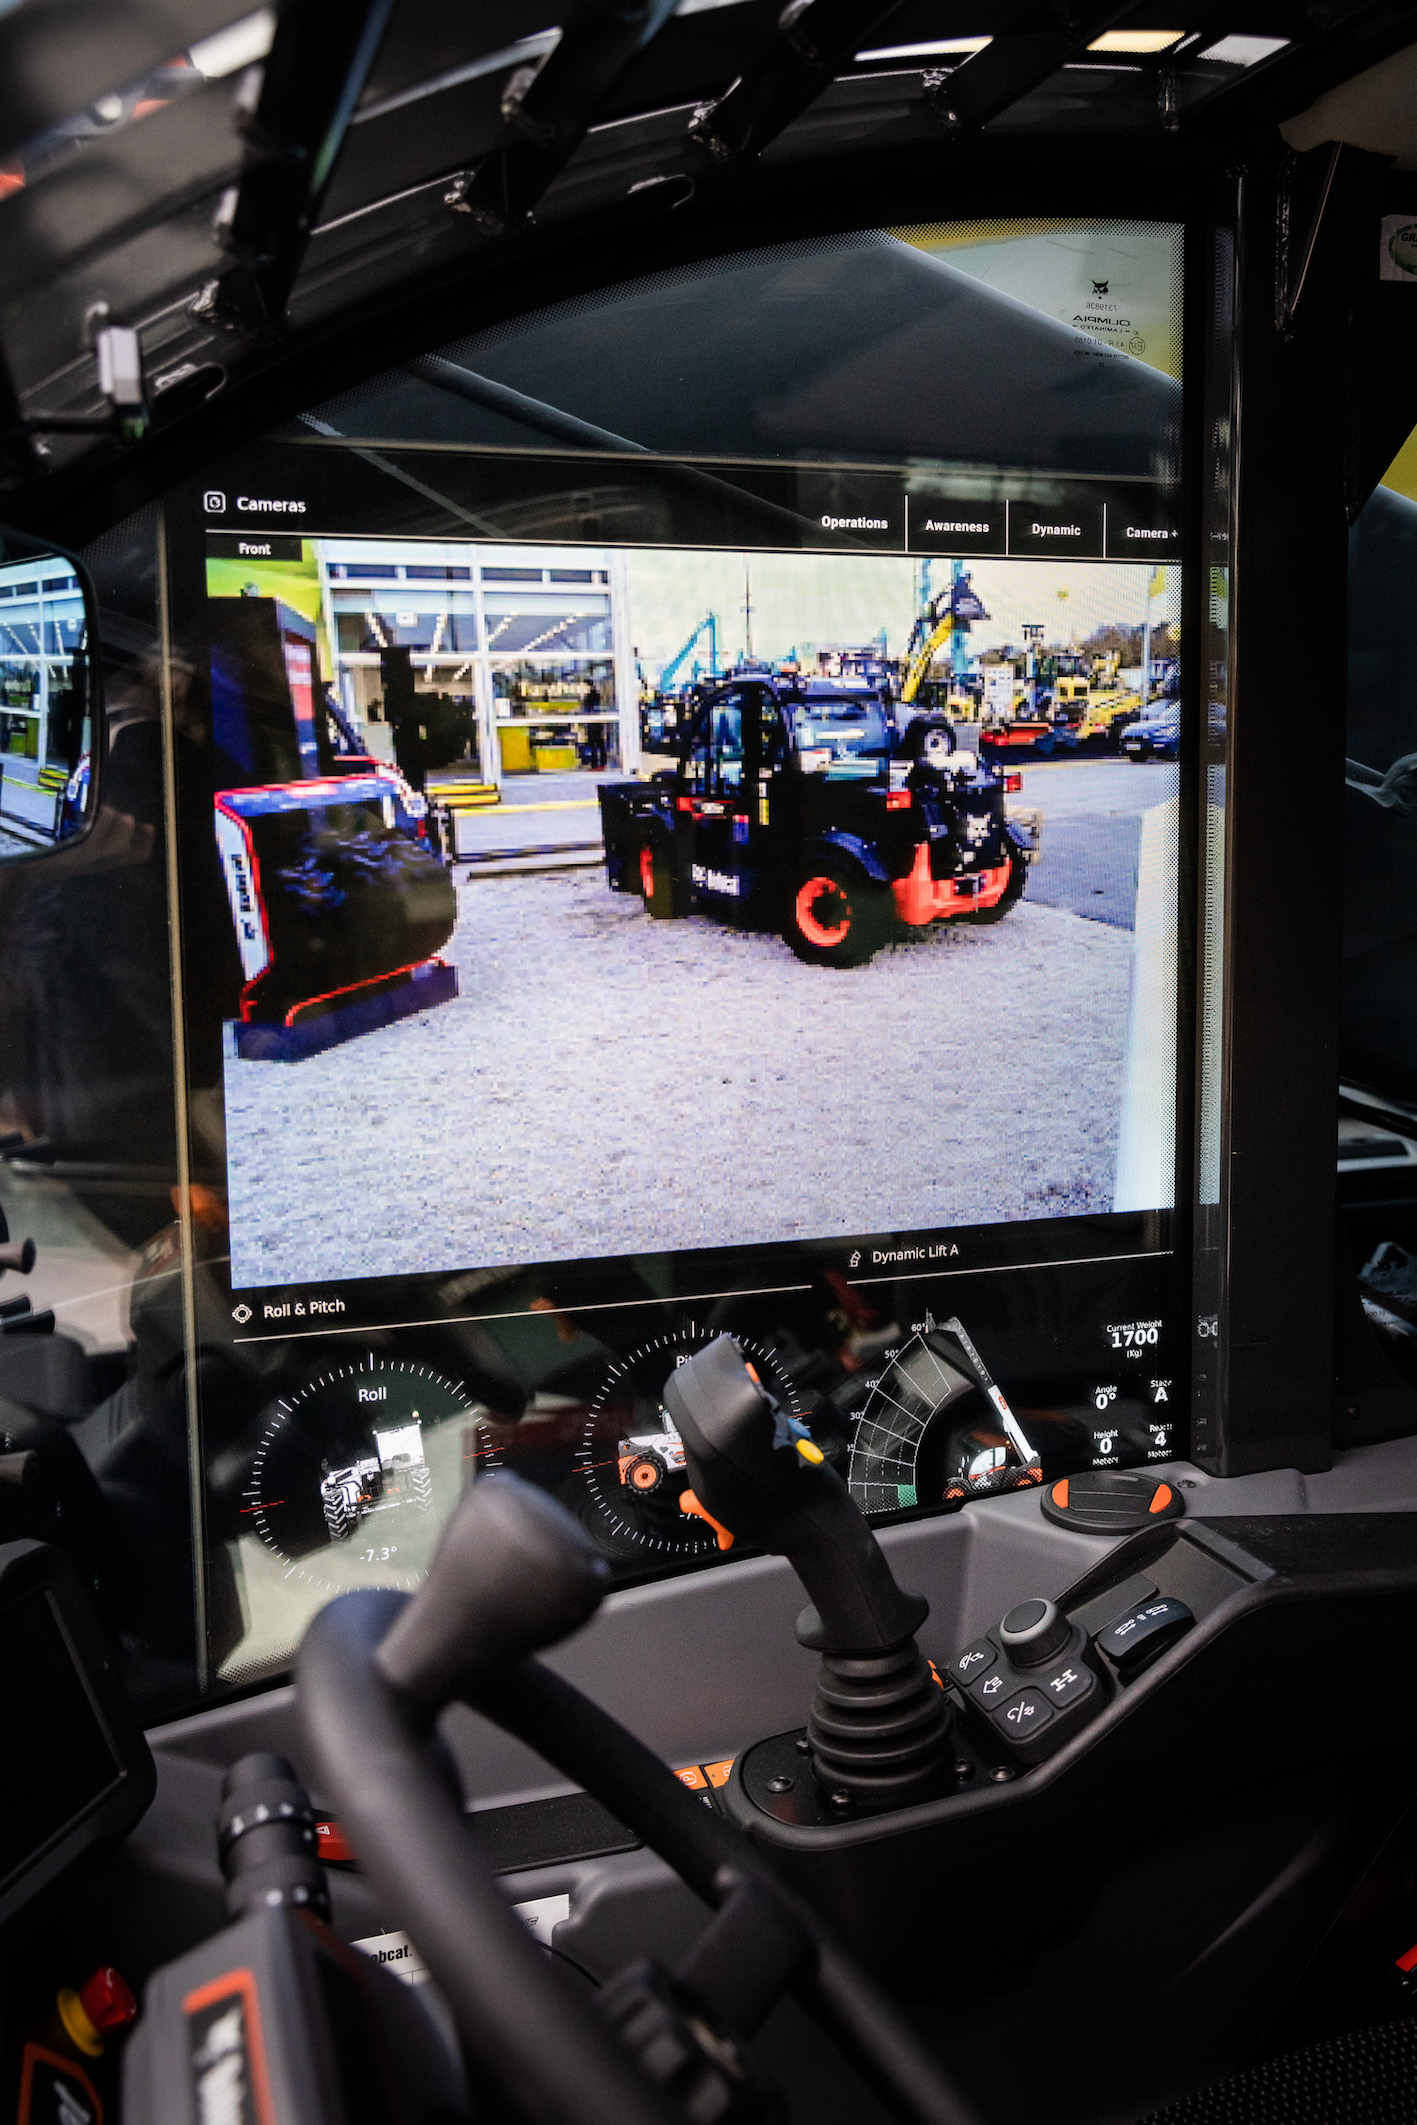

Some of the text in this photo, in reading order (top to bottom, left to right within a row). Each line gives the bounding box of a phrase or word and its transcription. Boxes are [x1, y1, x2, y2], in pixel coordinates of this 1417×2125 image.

[236, 496, 307, 514] Cameras
[821, 514, 889, 531] Operations
[925, 519, 990, 533] Awareness
[1031, 523, 1082, 538] Dynamic
[1126, 526, 1169, 540] Camera
[238, 541, 272, 556] Front
[872, 1244, 959, 1265] Dynamic Lift A
[263, 1298, 346, 1319] Roll & Pitch
[1106, 1319, 1163, 1333] Current Weight
[1111, 1328, 1159, 1349] 1700
[884, 1350, 899, 1359] 50°
[358, 1387, 387, 1402] Roll
[1094, 1385, 1118, 1395] Angle
[1154, 1386, 1168, 1403] A
[1095, 1392, 1117, 1410] 0°
[1093, 1429, 1119, 1440] Height
[1154, 1431, 1167, 1447] 4
[1099, 1438, 1112, 1454] 0
[359, 1545, 398, 1562] -7.3°
